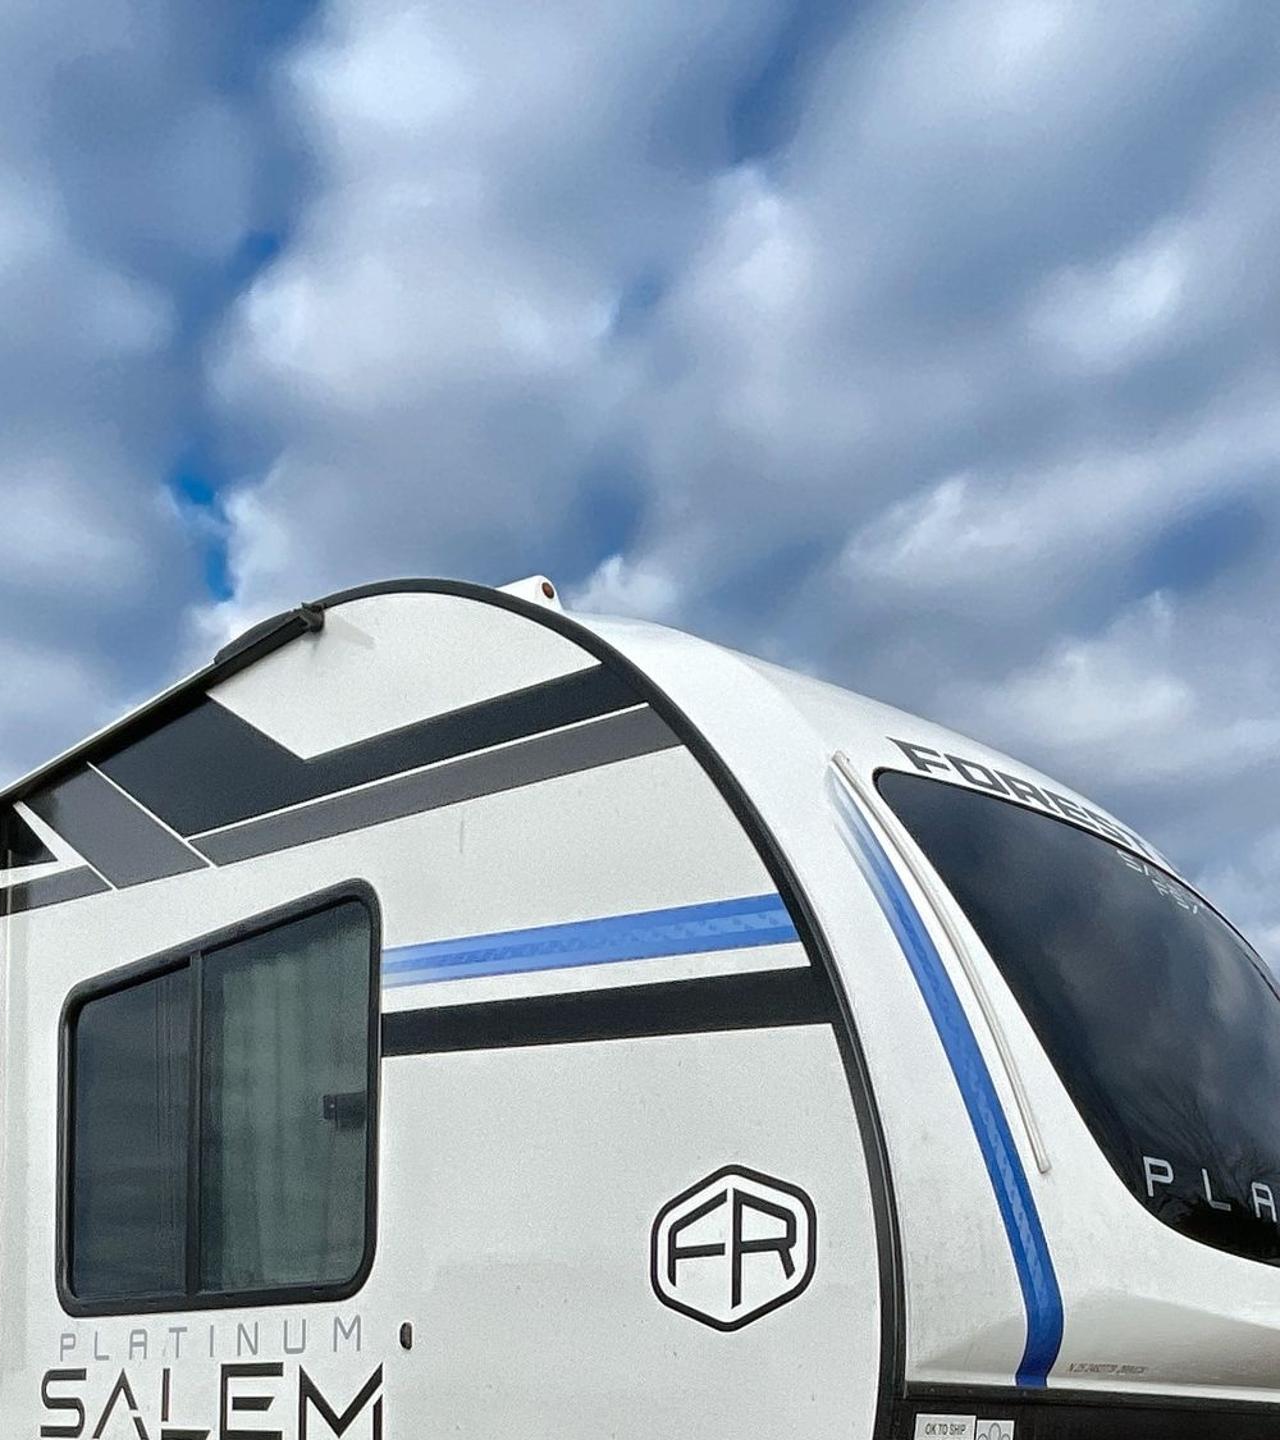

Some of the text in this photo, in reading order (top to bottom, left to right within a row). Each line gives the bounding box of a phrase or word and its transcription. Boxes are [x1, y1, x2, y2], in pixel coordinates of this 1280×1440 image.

[885, 736, 1154, 860] FOREST
[59, 1314, 362, 1362] PLATINUM
[925, 1423, 967, 1435] OK TO SHIP
